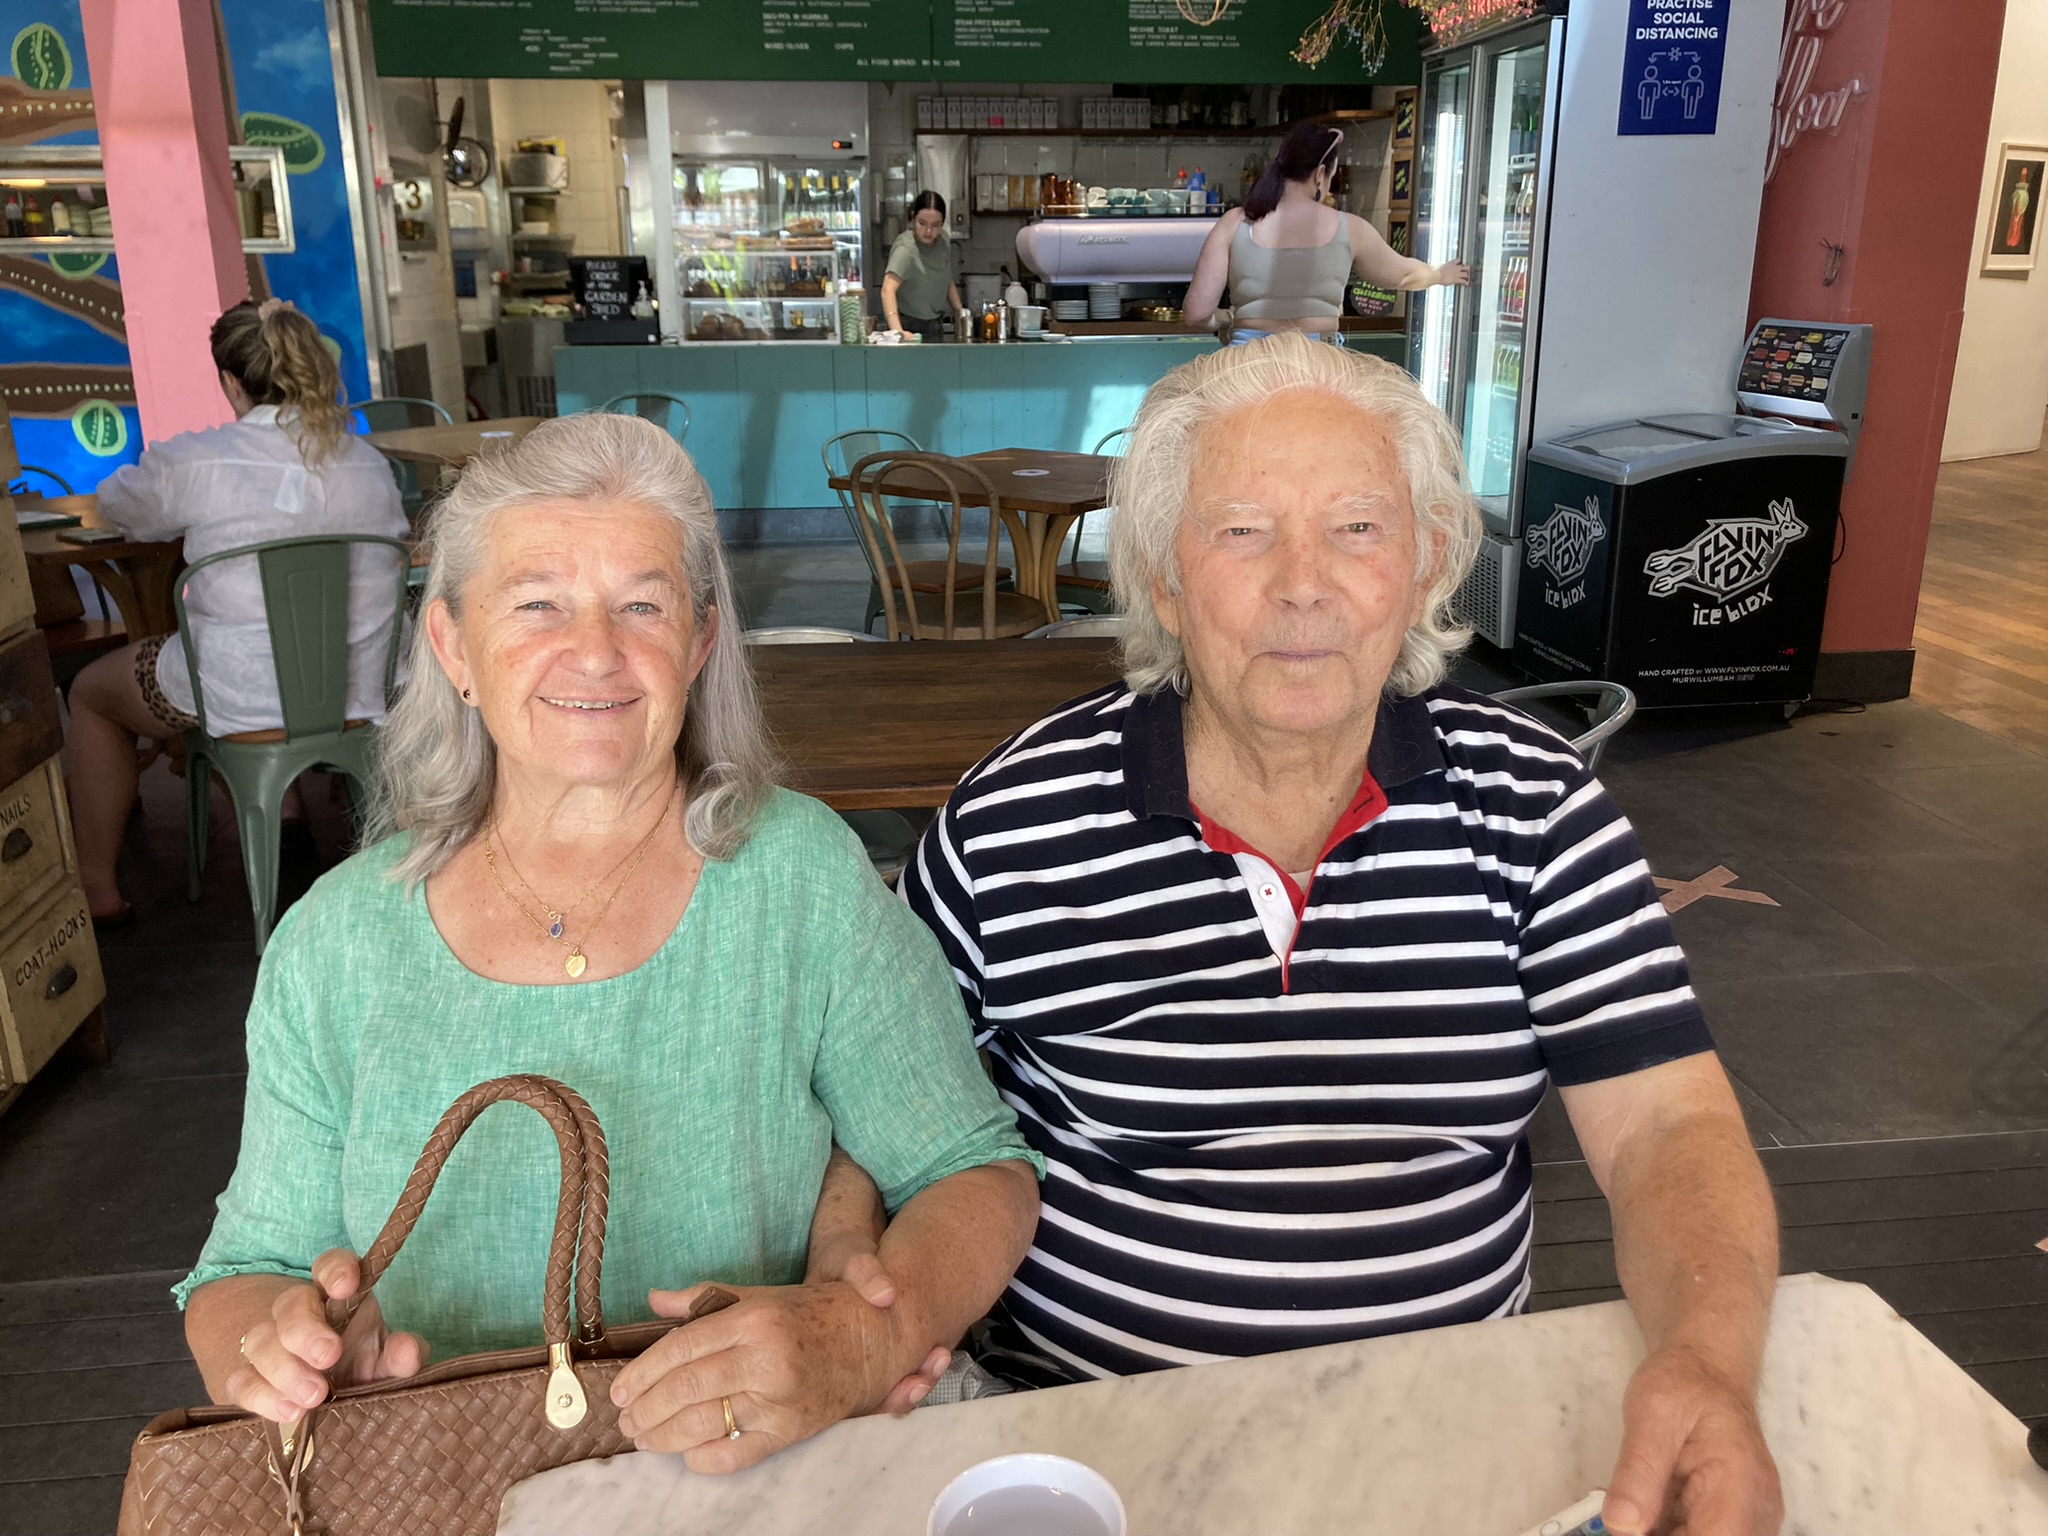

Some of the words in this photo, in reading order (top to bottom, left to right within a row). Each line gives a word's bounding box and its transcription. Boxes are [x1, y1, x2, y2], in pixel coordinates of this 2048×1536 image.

[1647, 0, 1713, 9] PRACTISE
[1653, 12, 1704, 25] SOCIAL
[1636, 27, 1719, 40] DISTANCING
[405, 180, 421, 209] 3
[1554, 541, 1583, 574] FOX
[1709, 546, 1766, 588] FOX
[1545, 581, 1560, 608] ice
[1692, 602, 1722, 626] ice
[1638, 669, 1660, 677] HAND
[1660, 668, 1695, 677] CRAFTED
[1704, 664, 1790, 675] WWW.FLYINFOX.COM.AU
[1672, 675, 1735, 684] MURWILLUMBAH
[0, 794, 32, 829] NAILS
[15, 910, 87, 986] COAT-HOOKS
